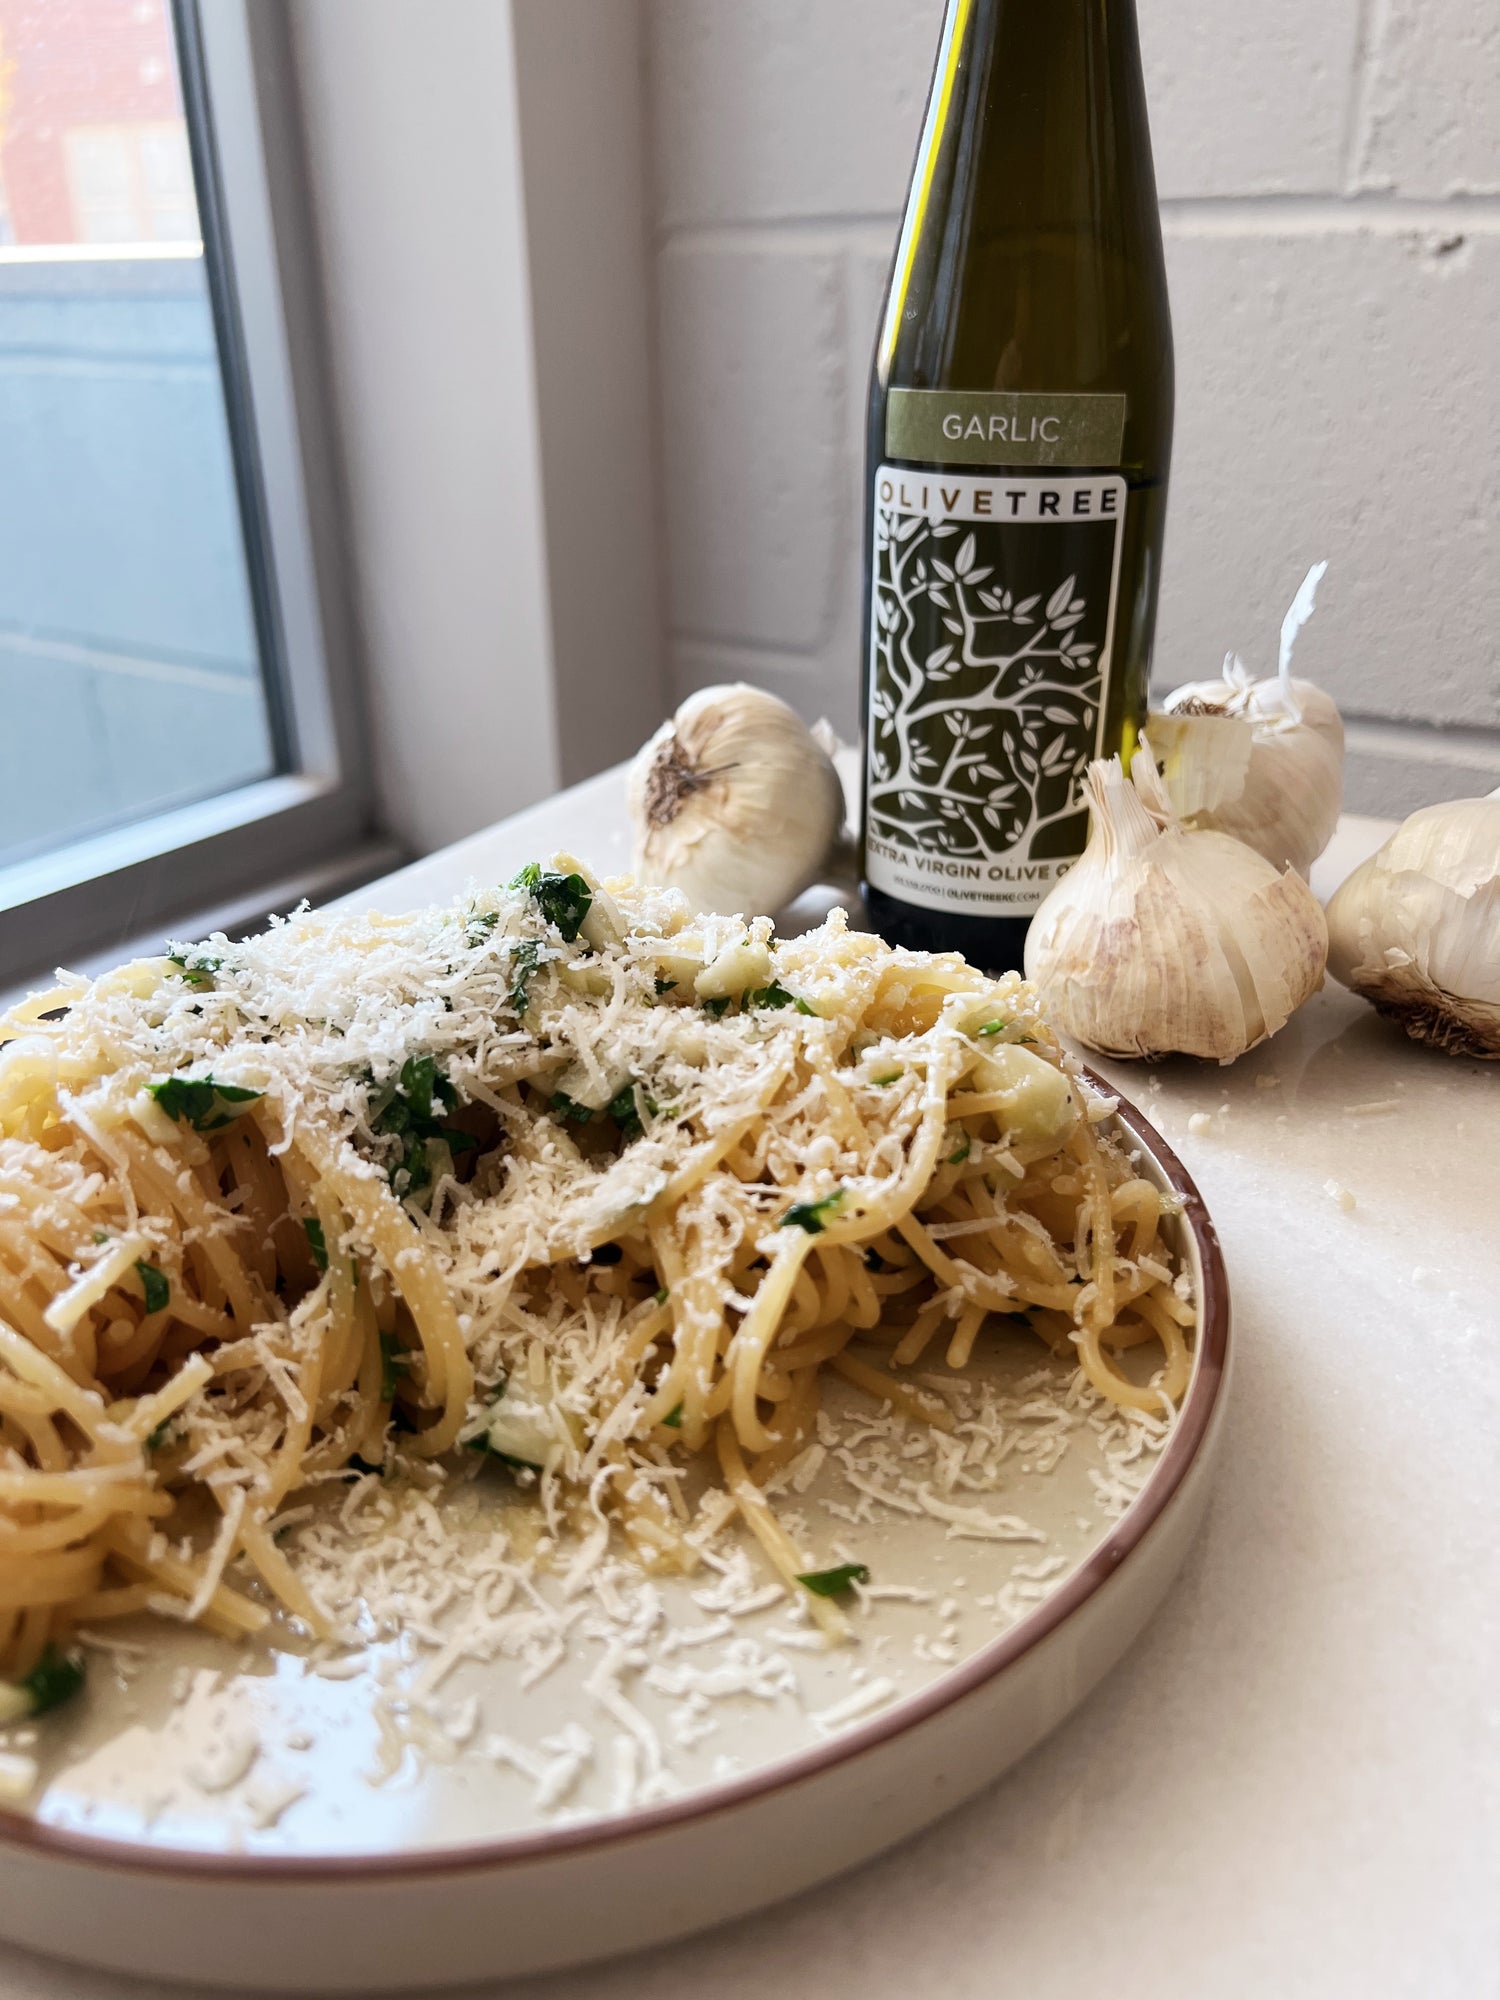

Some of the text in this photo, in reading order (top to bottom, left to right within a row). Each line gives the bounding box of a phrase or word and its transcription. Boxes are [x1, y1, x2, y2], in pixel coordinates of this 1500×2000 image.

[942, 414, 1061, 442] GARLIC
[879, 480, 1117, 516] OLIVETREE
[866, 837, 908, 866] EXTRA
[914, 855, 980, 880] VIRGIN
[988, 865, 1050, 881] OLIVE
